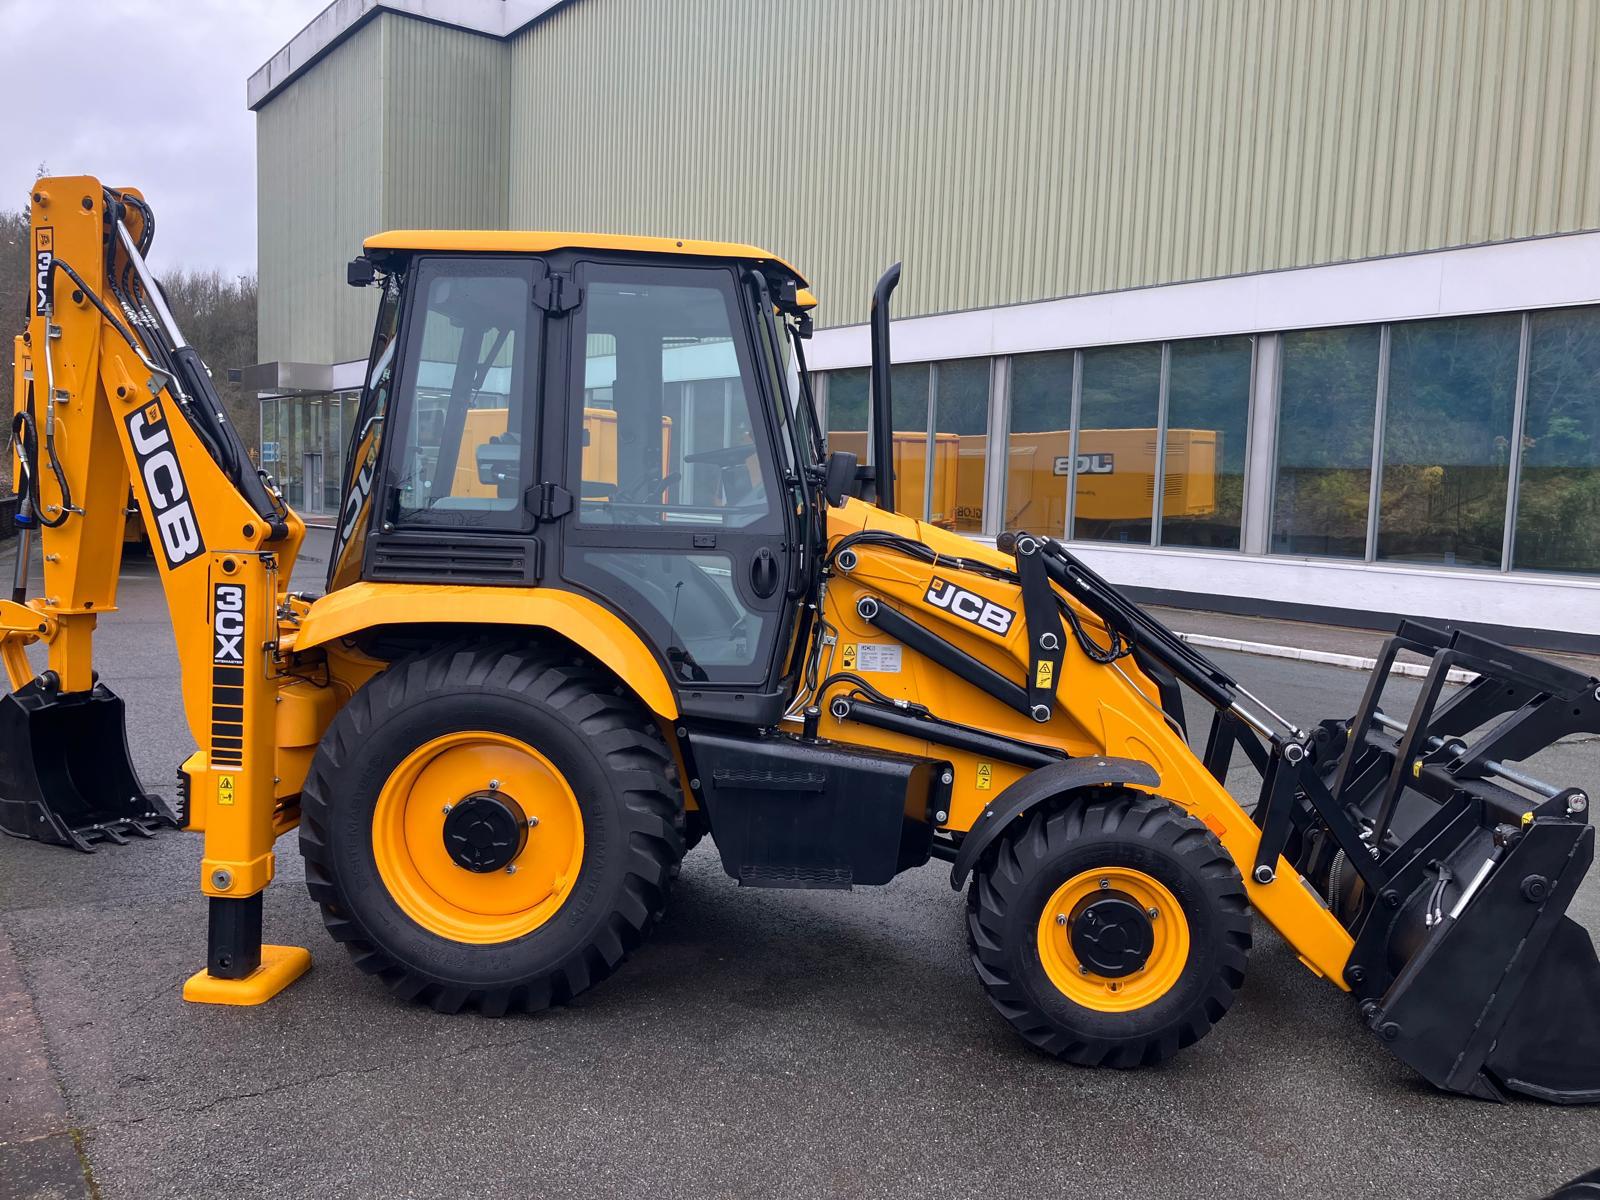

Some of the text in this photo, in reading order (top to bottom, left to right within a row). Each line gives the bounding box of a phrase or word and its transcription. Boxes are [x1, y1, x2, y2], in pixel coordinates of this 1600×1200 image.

[130, 412, 199, 563] JCB
[214, 586, 244, 659] 3CX
[927, 584, 1011, 633] JCB
